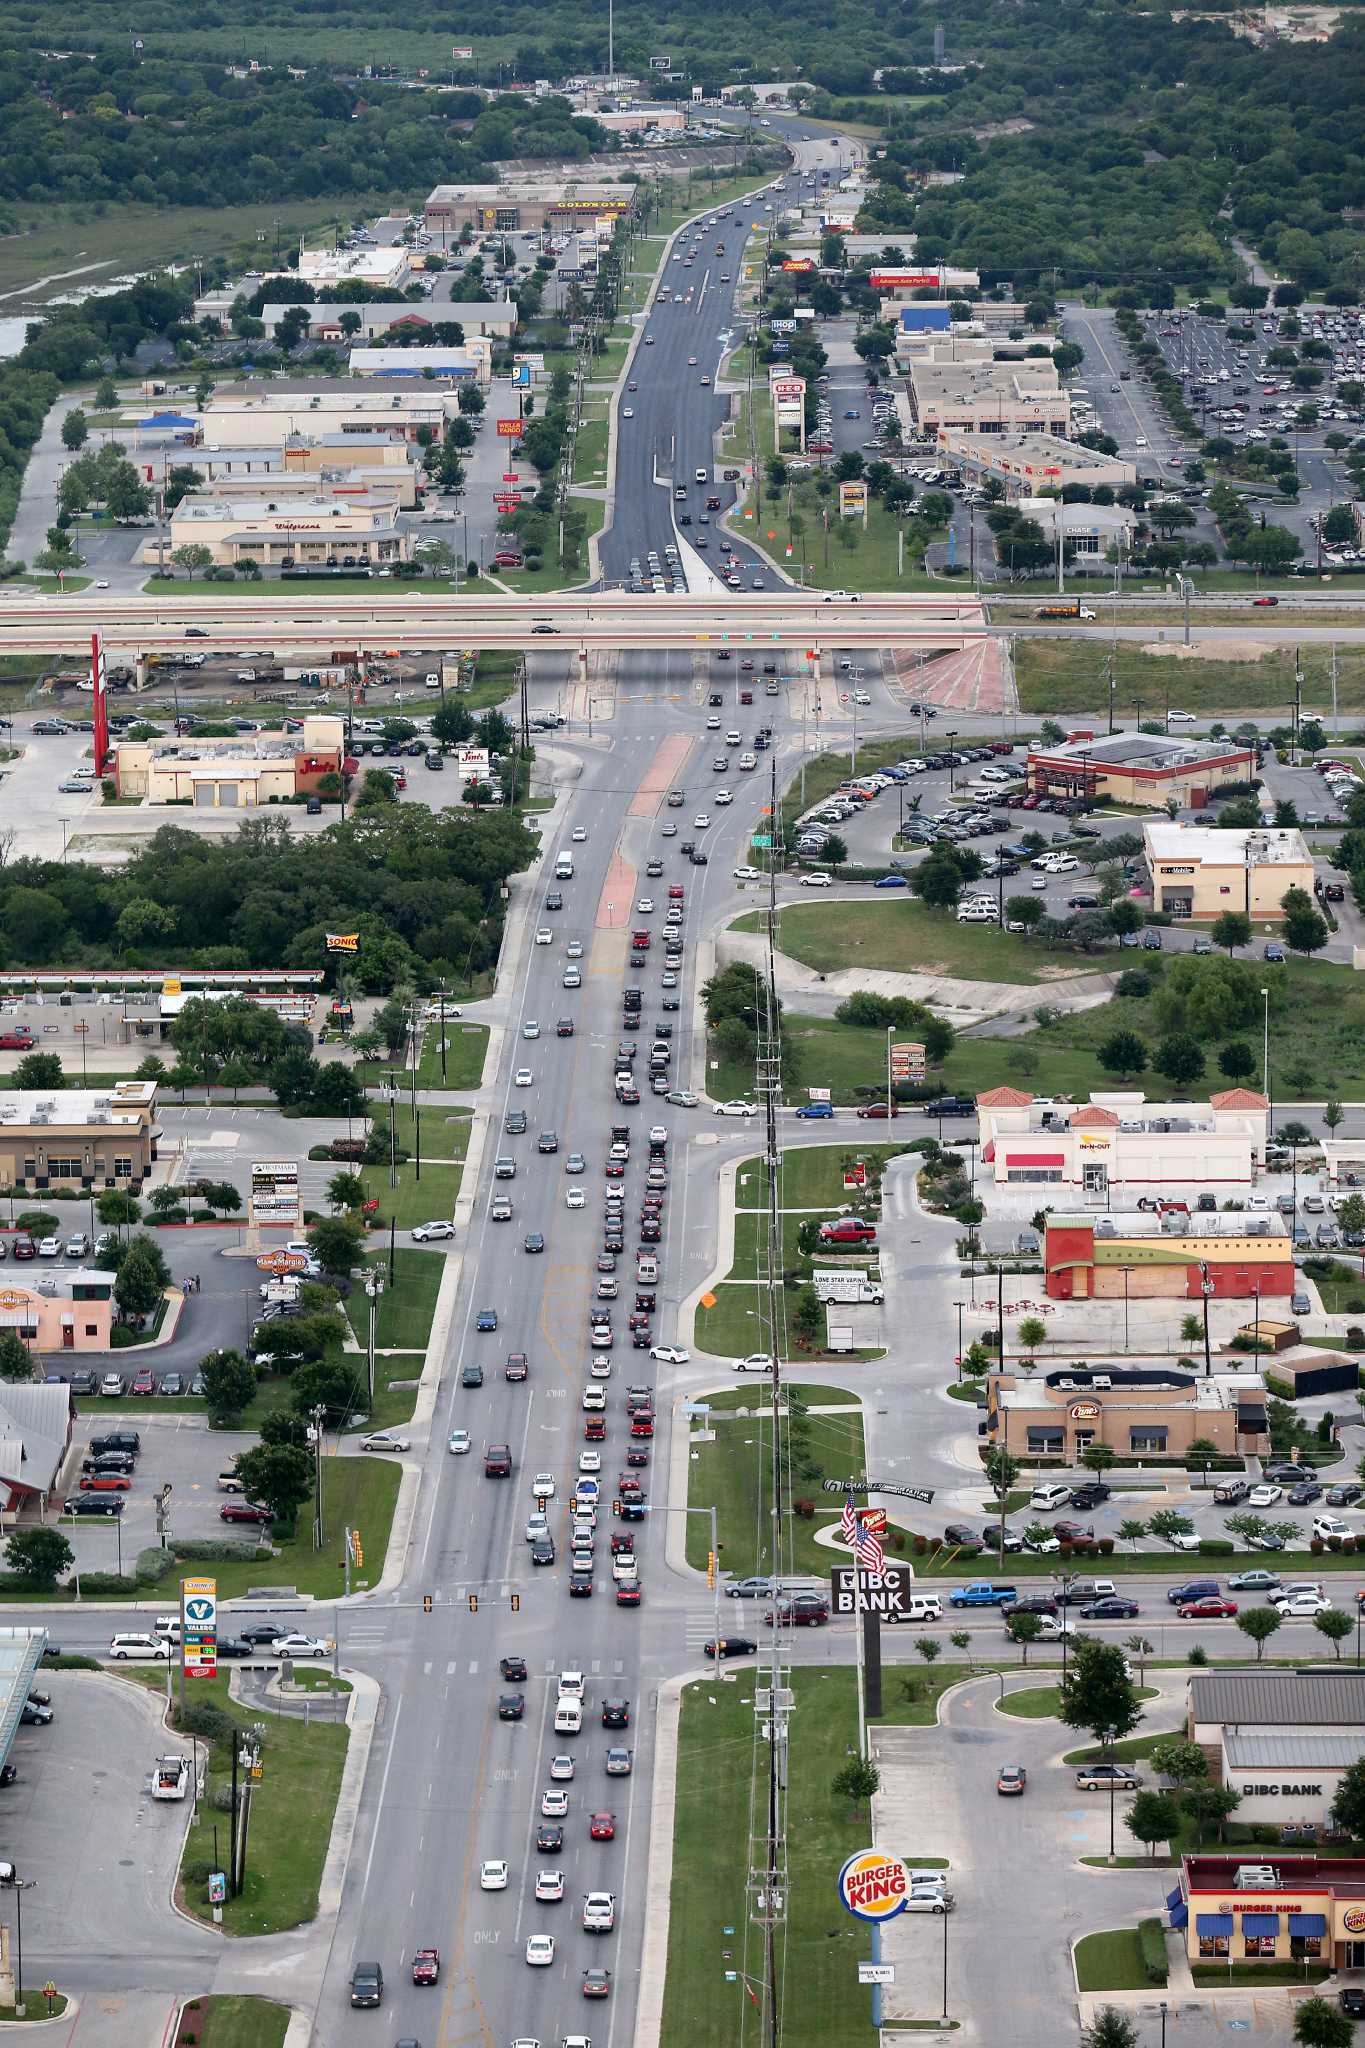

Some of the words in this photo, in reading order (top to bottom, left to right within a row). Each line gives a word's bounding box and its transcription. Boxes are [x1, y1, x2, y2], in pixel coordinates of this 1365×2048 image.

[275, 523, 321, 531] Walgreens
[461, 751, 484, 762] Jim's
[328, 938, 358, 946] SONIC
[860, 1571, 900, 1589] IBC
[838, 1592, 904, 1611] BANK
[1254, 1784, 1279, 1796] IBC
[1281, 1784, 1322, 1796] BANK
[847, 1864, 903, 1890] BURGER
[850, 1876, 906, 1908] KING
[1232, 1904, 1273, 1912] BURGER
[1275, 1904, 1302, 1912] KING
